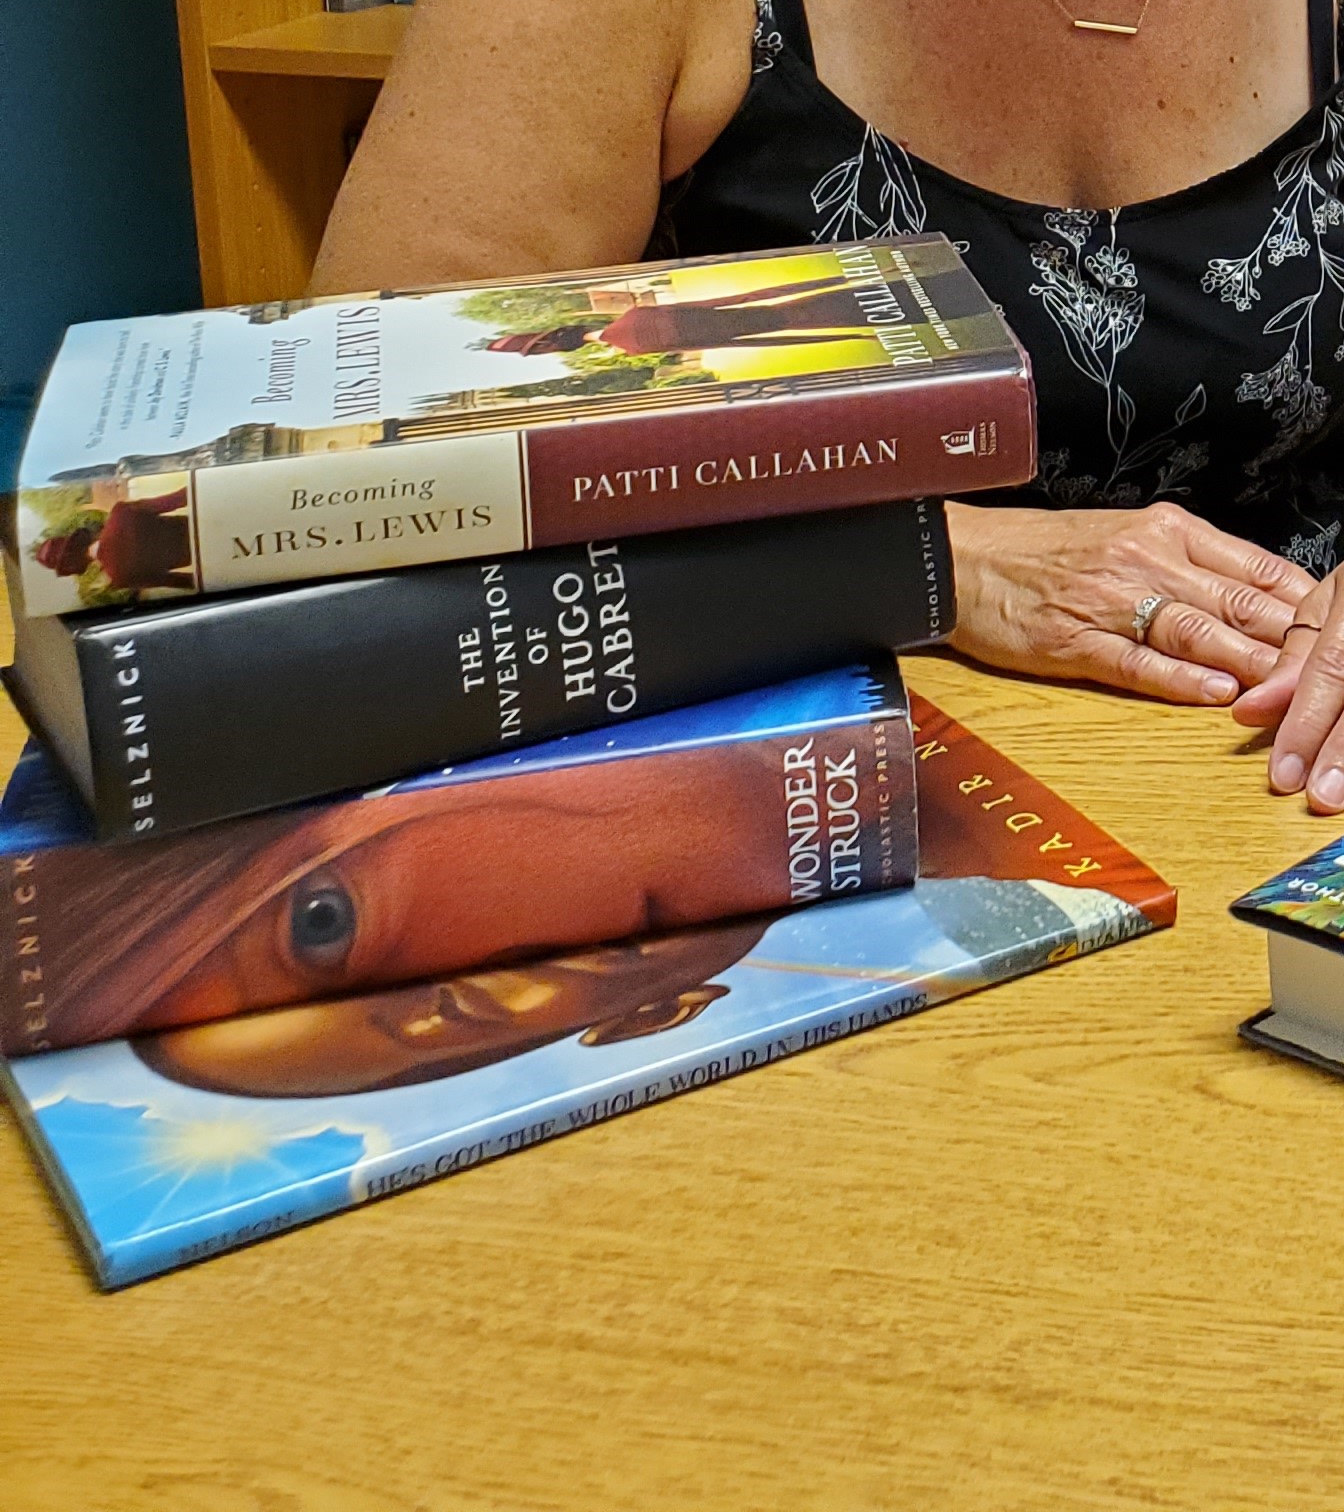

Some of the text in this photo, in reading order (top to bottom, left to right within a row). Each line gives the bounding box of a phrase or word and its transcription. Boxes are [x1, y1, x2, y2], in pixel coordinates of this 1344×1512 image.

[848, 242, 933, 368] PATTI CALLAHAN
[250, 336, 311, 406] Becoming
[290, 474, 436, 512] Becoming
[572, 439, 900, 503] PATTI CALLAHAN
[461, 625, 486, 693] THE
[483, 563, 523, 739] INVENTION
[529, 626, 550, 665] OF
[558, 571, 598, 702] HUGO
[595, 540, 638, 714] CABRET
[118, 636, 154, 831] SELZNICK
[780, 734, 819, 907] WONDER
[823, 745, 859, 891] STRUCK
[958, 774, 1102, 879] KADIR
[364, 992, 929, 1201] HE'S GOT THE WHOLE WORLD IN HIS HANDS
